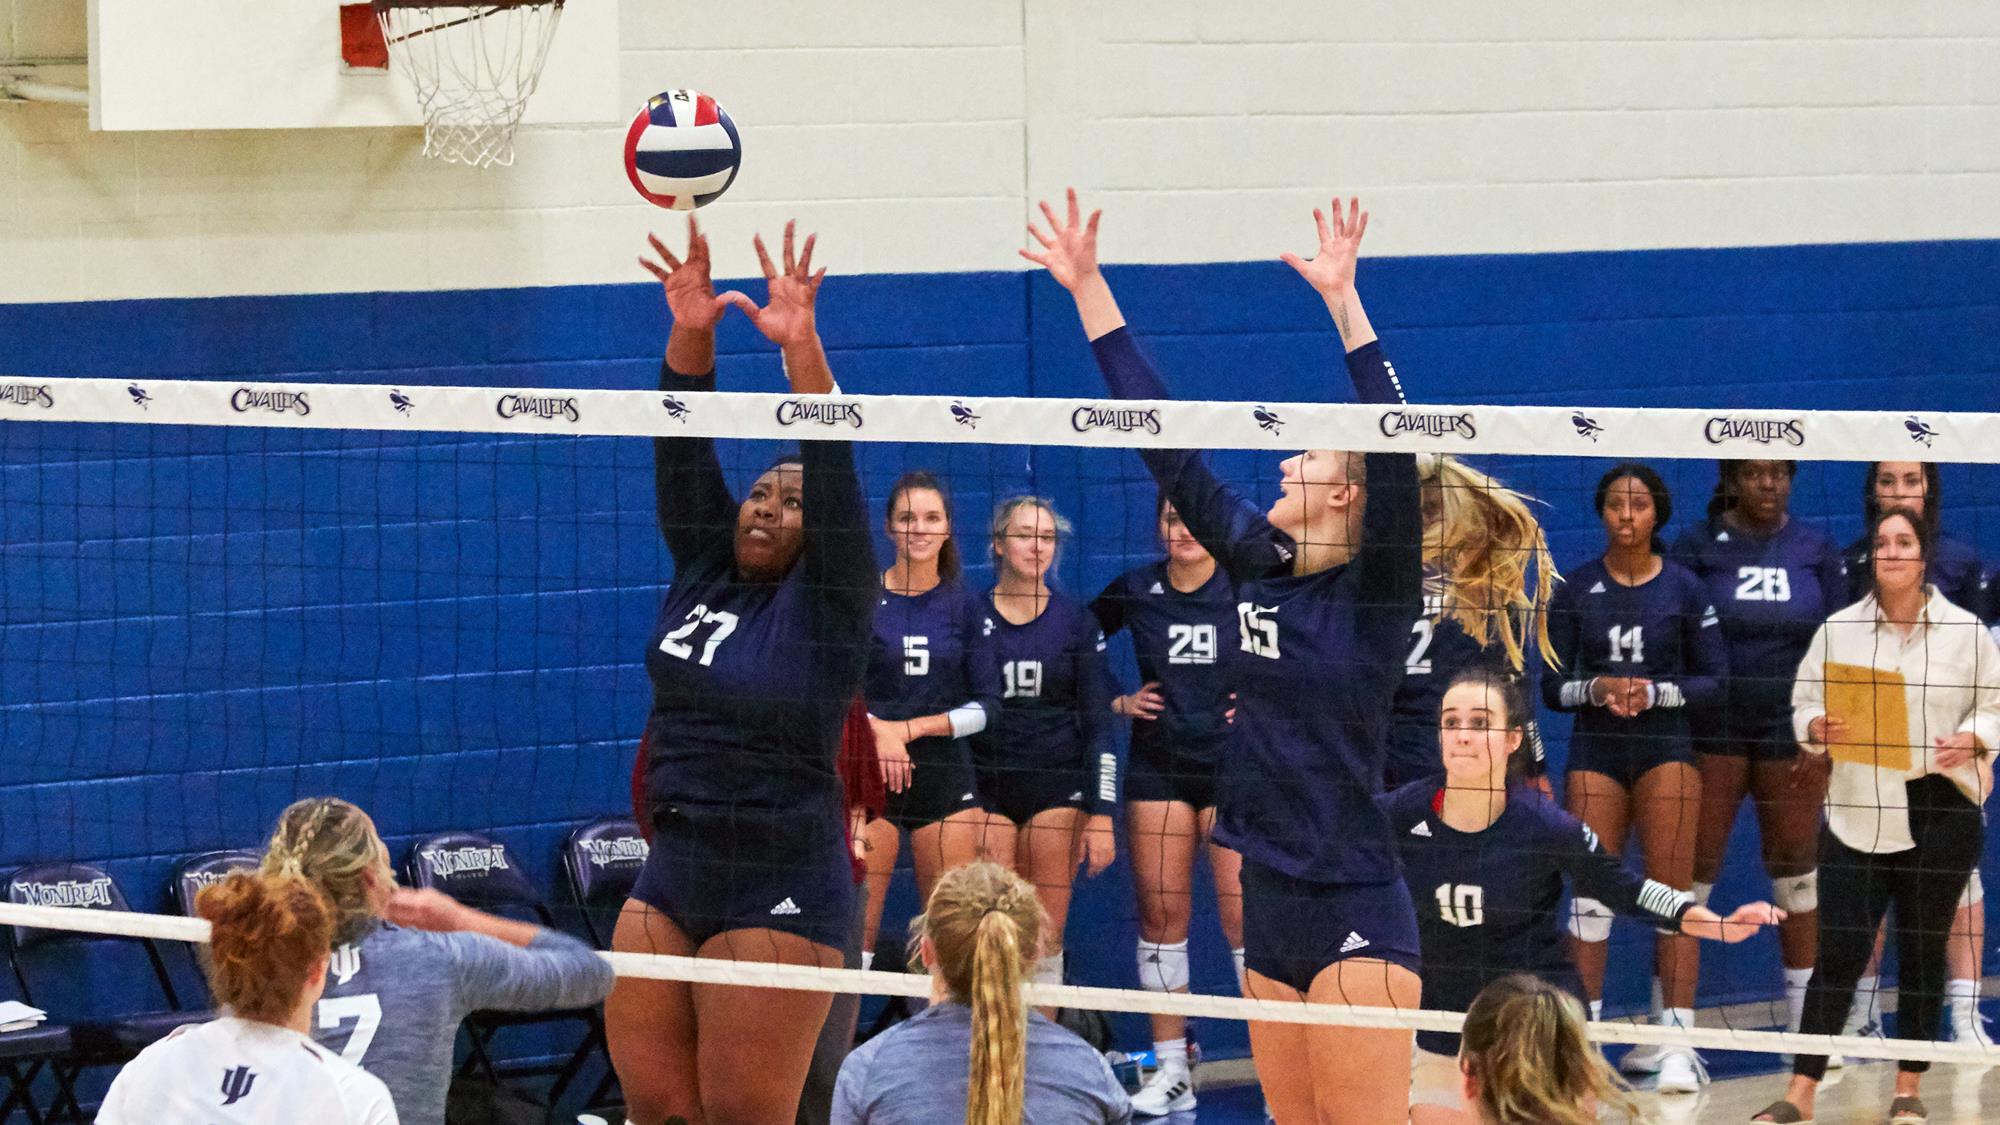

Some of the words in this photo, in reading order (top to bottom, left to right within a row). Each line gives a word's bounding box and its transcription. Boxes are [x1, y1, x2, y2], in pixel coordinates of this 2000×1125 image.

[0, 384, 53, 408] VALIERS
[231, 388, 310, 416] CAVALIERS
[496, 394, 579, 422] CAVALIERS
[776, 401, 862, 429] CAVALIERS
[1072, 406, 1160, 435] CAVALIERS
[1380, 411, 1475, 439] CAVALIERS
[1705, 417, 1803, 446] CAVALIERS
[1735, 566, 1791, 601] 28
[659, 604, 739, 667] 27
[1168, 624, 1217, 664] 29
[1238, 602, 1281, 660] 15
[1608, 625, 1644, 662] 14
[903, 636, 929, 675] 5
[1003, 661, 1042, 698] 19
[421, 845, 509, 880] MONTREAT
[13, 877, 112, 907] MONTREAT
[1435, 883, 1485, 927] 10
[318, 994, 382, 1067] 7
